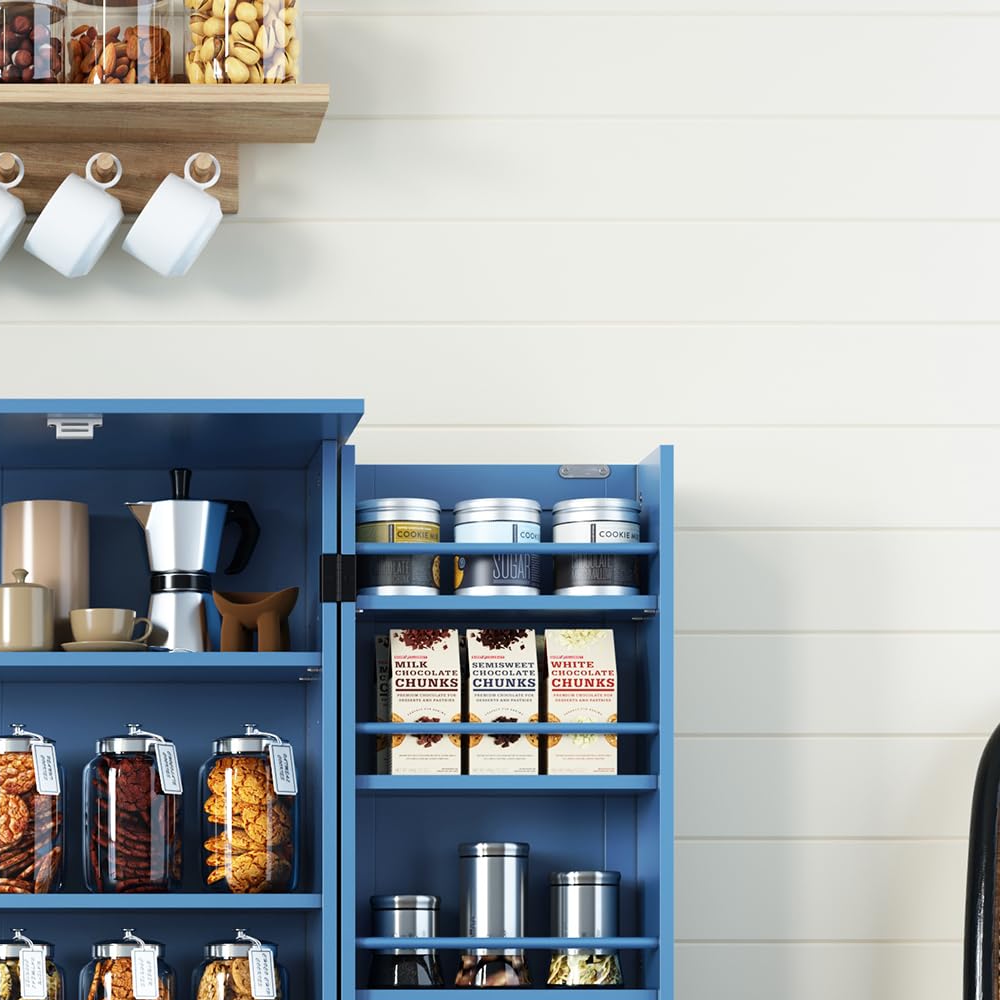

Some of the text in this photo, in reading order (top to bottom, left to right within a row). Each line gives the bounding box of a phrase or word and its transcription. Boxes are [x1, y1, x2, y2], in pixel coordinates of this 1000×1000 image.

[396, 530, 429, 539] COOKIE
[599, 530, 630, 539] COOKIE
[492, 553, 531, 580] SUGAR
[395, 678, 458, 688] CHUNKS
[472, 678, 536, 688] CHUNKS
[551, 678, 615, 688] CHUNKS
